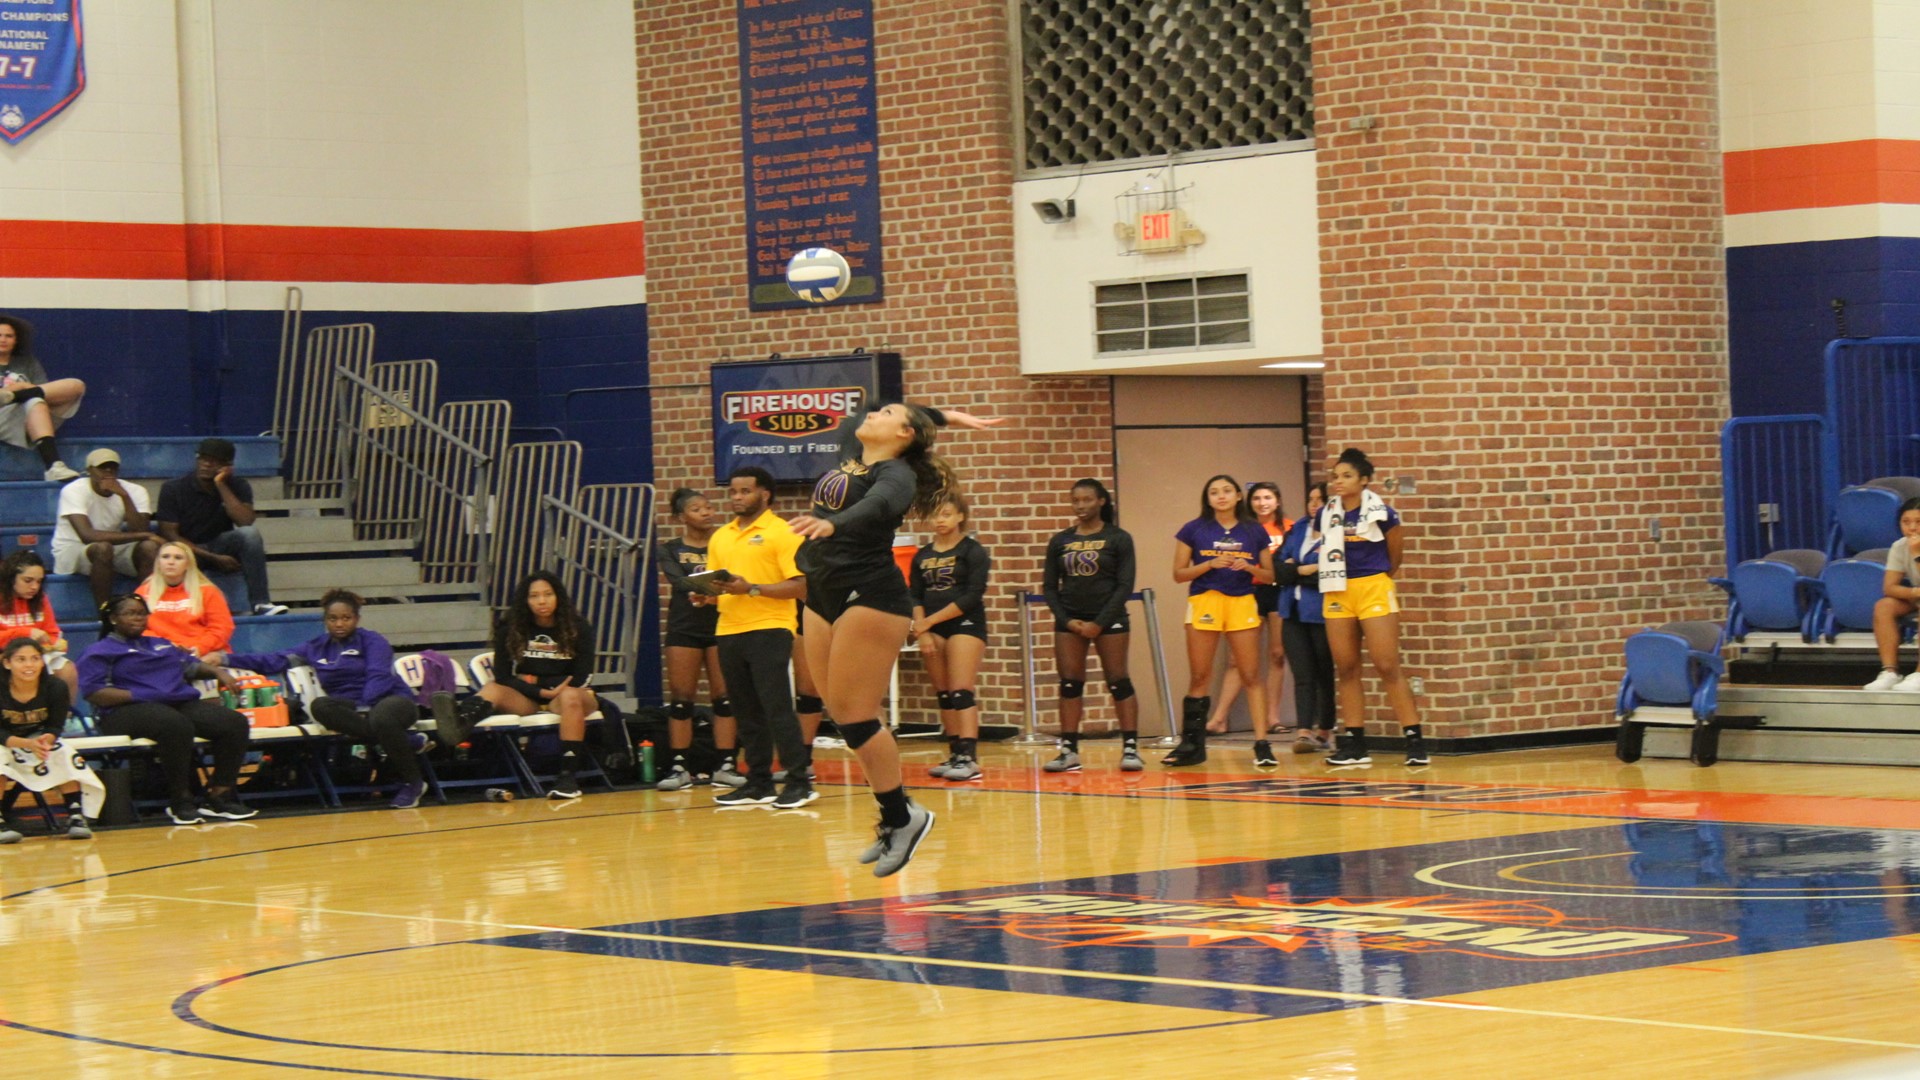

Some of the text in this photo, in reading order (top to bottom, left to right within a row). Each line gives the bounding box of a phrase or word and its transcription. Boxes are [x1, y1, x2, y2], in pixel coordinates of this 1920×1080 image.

[1, 11, 69, 22] CHAMPIONS
[0, 30, 49, 40] ATIONAL
[1142, 213, 1170, 241] EXIT
[727, 391, 861, 424] FIREHOUSE
[768, 413, 819, 431] SUBS
[1062, 550, 1099, 577] 18
[922, 566, 957, 591] 15
[902, 893, 1692, 957] SOUTHLAND
